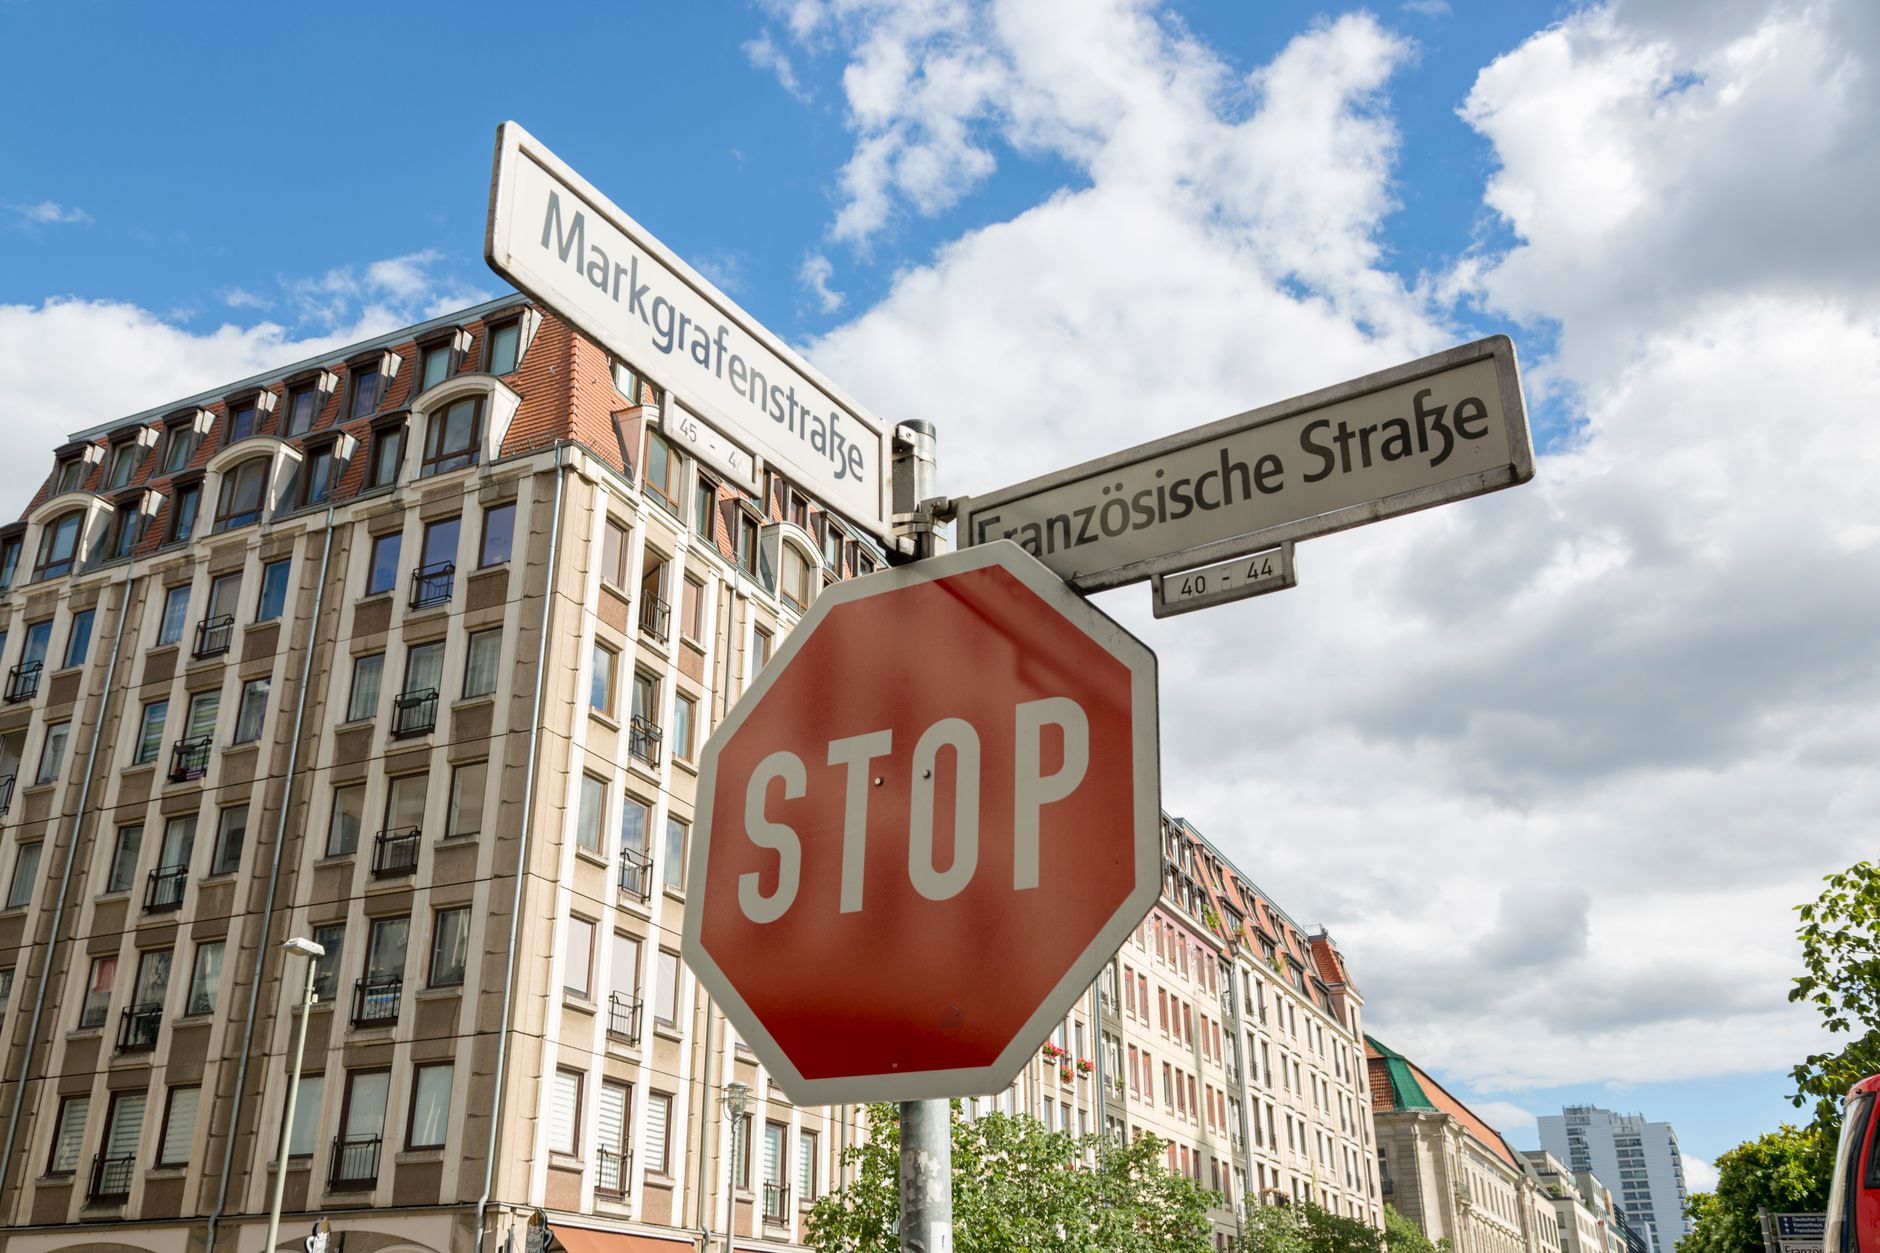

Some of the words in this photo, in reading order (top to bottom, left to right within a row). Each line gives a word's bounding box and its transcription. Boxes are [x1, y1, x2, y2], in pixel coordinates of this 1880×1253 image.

[541, 190, 863, 482] Markgrafenstraße
[680, 418, 697, 443] 45
[1300, 388, 1489, 483] Straße
[1181, 575, 1206, 596] 40
[1247, 558, 1273, 580] 44
[738, 696, 1090, 924] STOP
